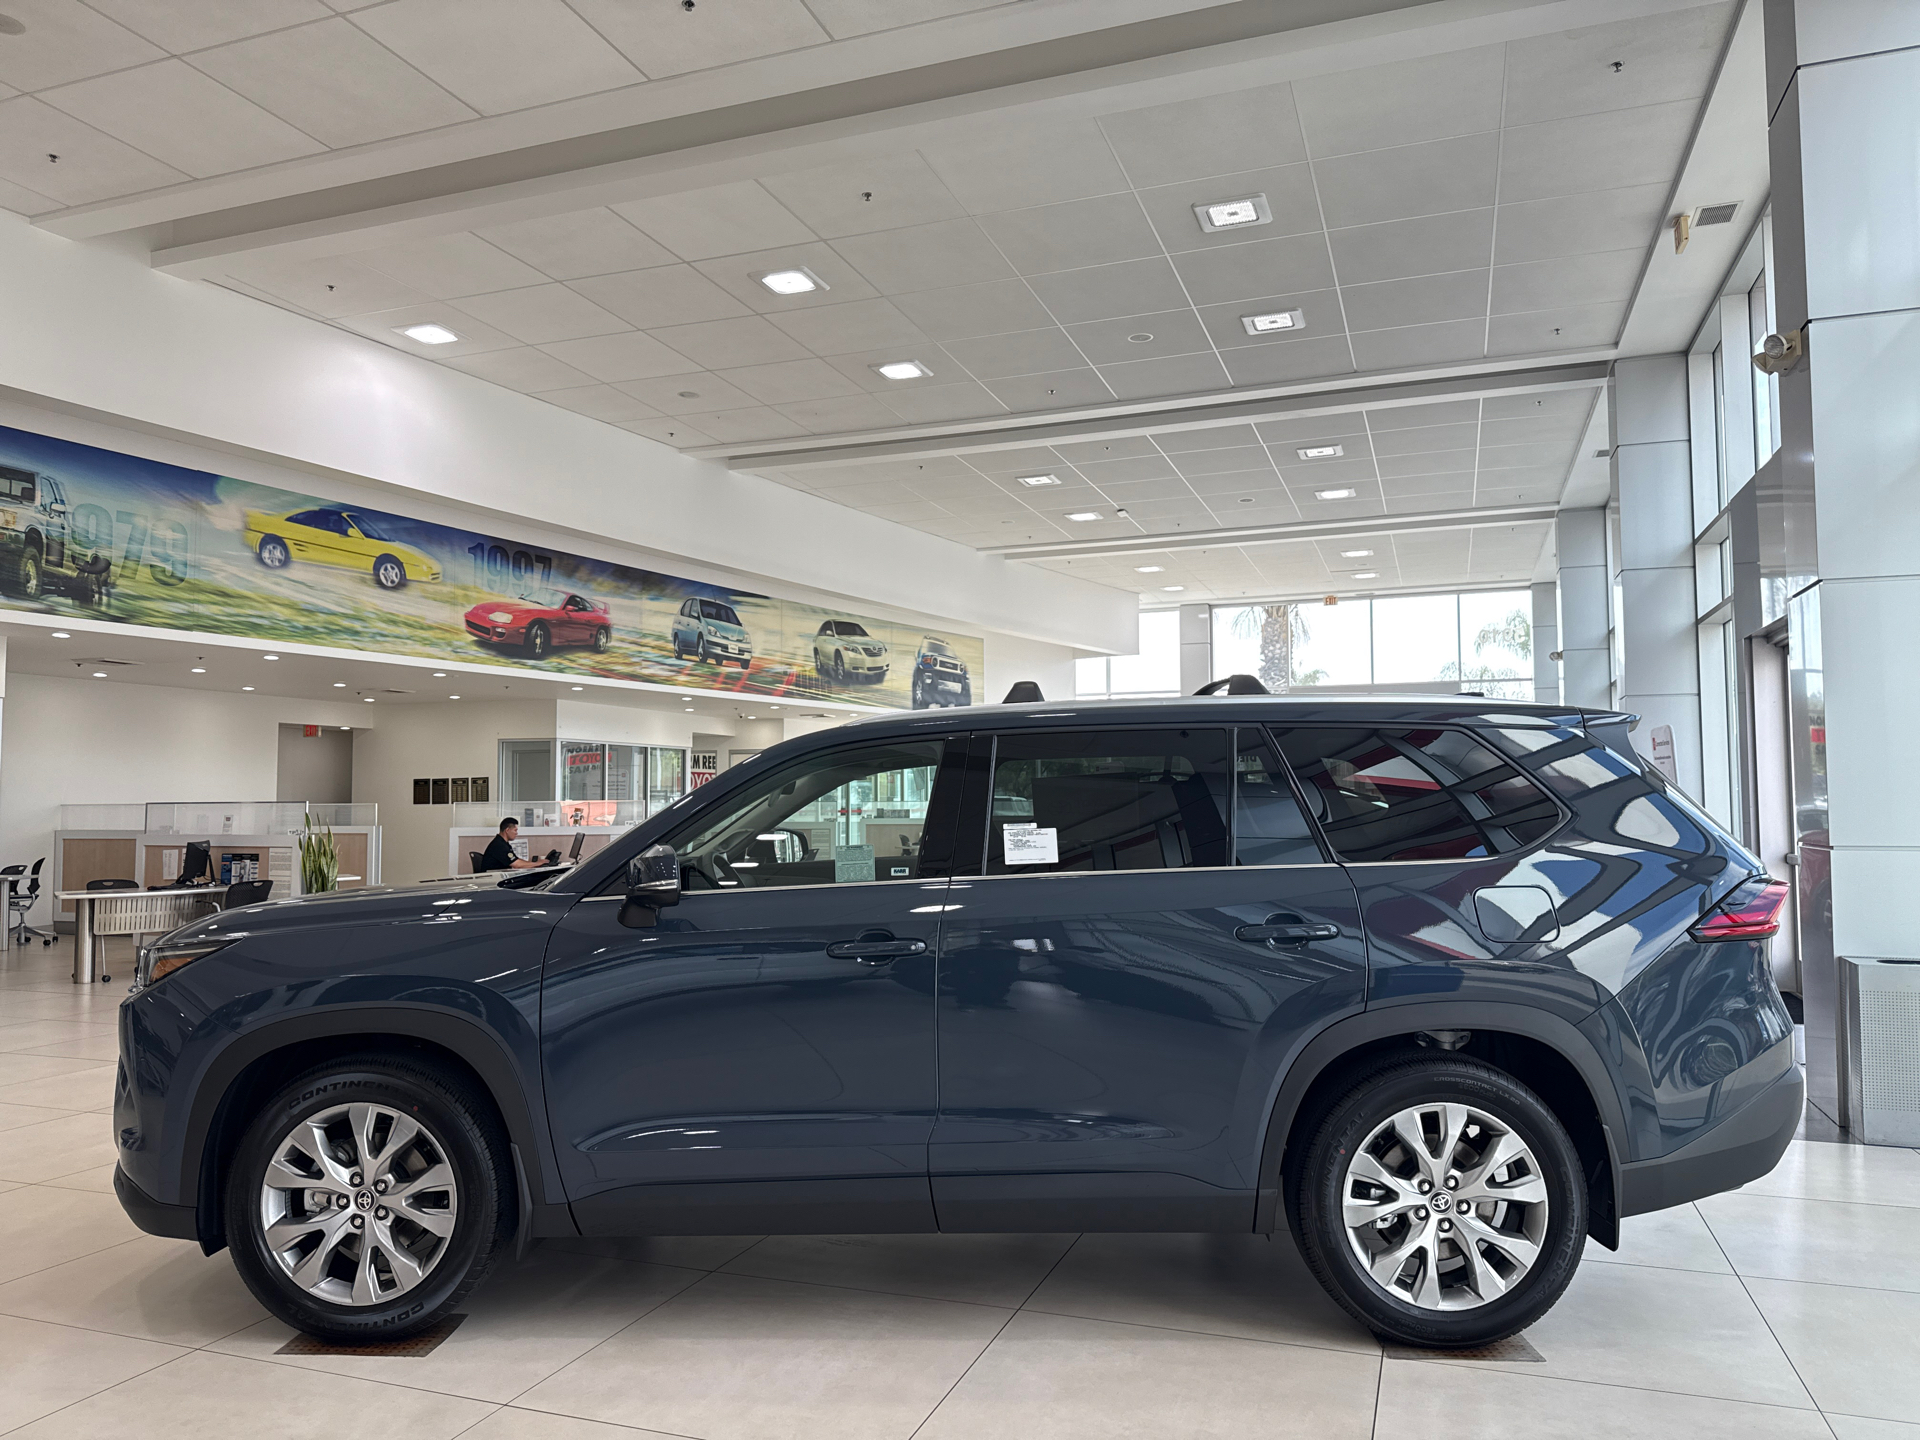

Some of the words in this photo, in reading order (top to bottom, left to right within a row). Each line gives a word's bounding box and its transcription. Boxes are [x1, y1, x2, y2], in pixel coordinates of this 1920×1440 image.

[467, 542, 552, 596] 1997
[1325, 597, 1337, 605] EXIT
[1433, 1076, 1498, 1092] CROSSCONTACT
[1533, 1166, 1577, 1301] CONTINENTAL
